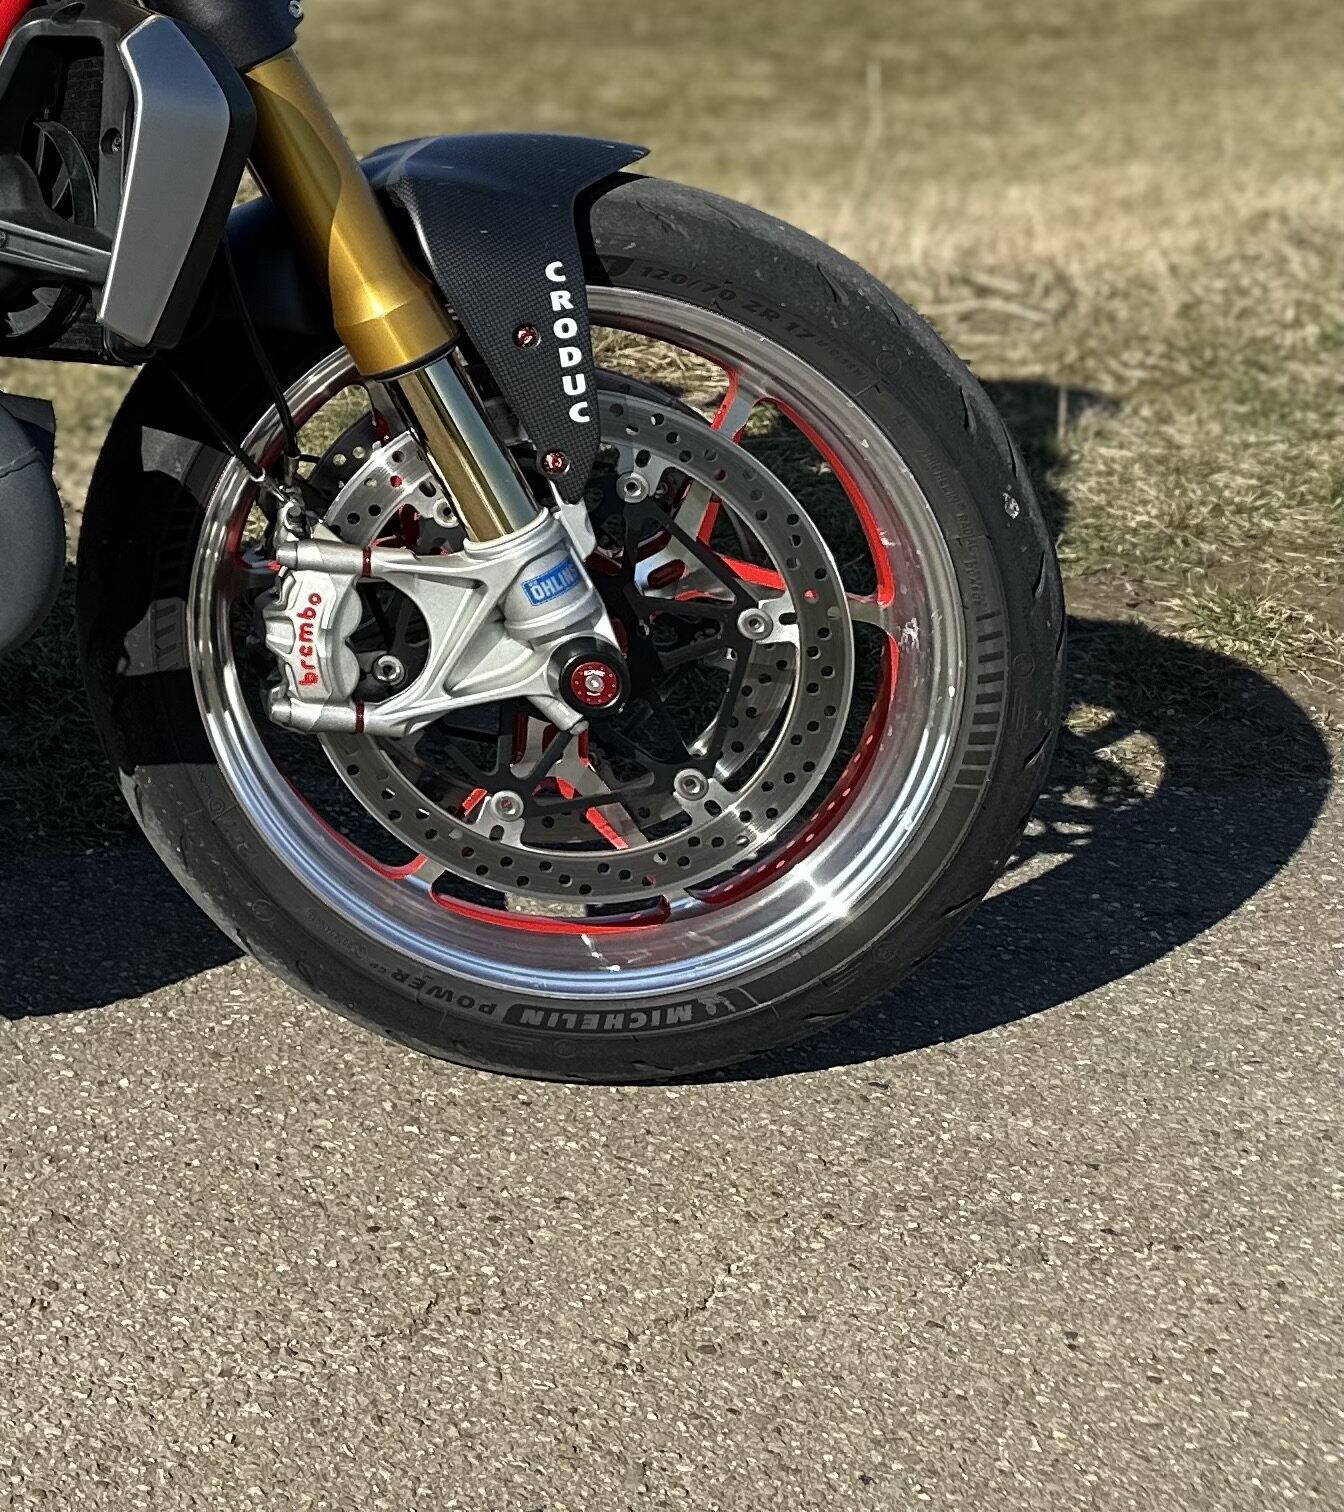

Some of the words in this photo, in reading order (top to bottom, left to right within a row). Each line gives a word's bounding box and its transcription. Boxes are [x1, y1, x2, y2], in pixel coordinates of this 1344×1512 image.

[641, 266, 737, 301] 120/70
[742, 299, 780, 322] ZR
[785, 321, 816, 338] 17
[545, 261, 590, 423] CRODUC
[296, 592, 322, 686] brembo
[391, 967, 497, 1016] POWER
[520, 1003, 692, 1030] MICHELIN
